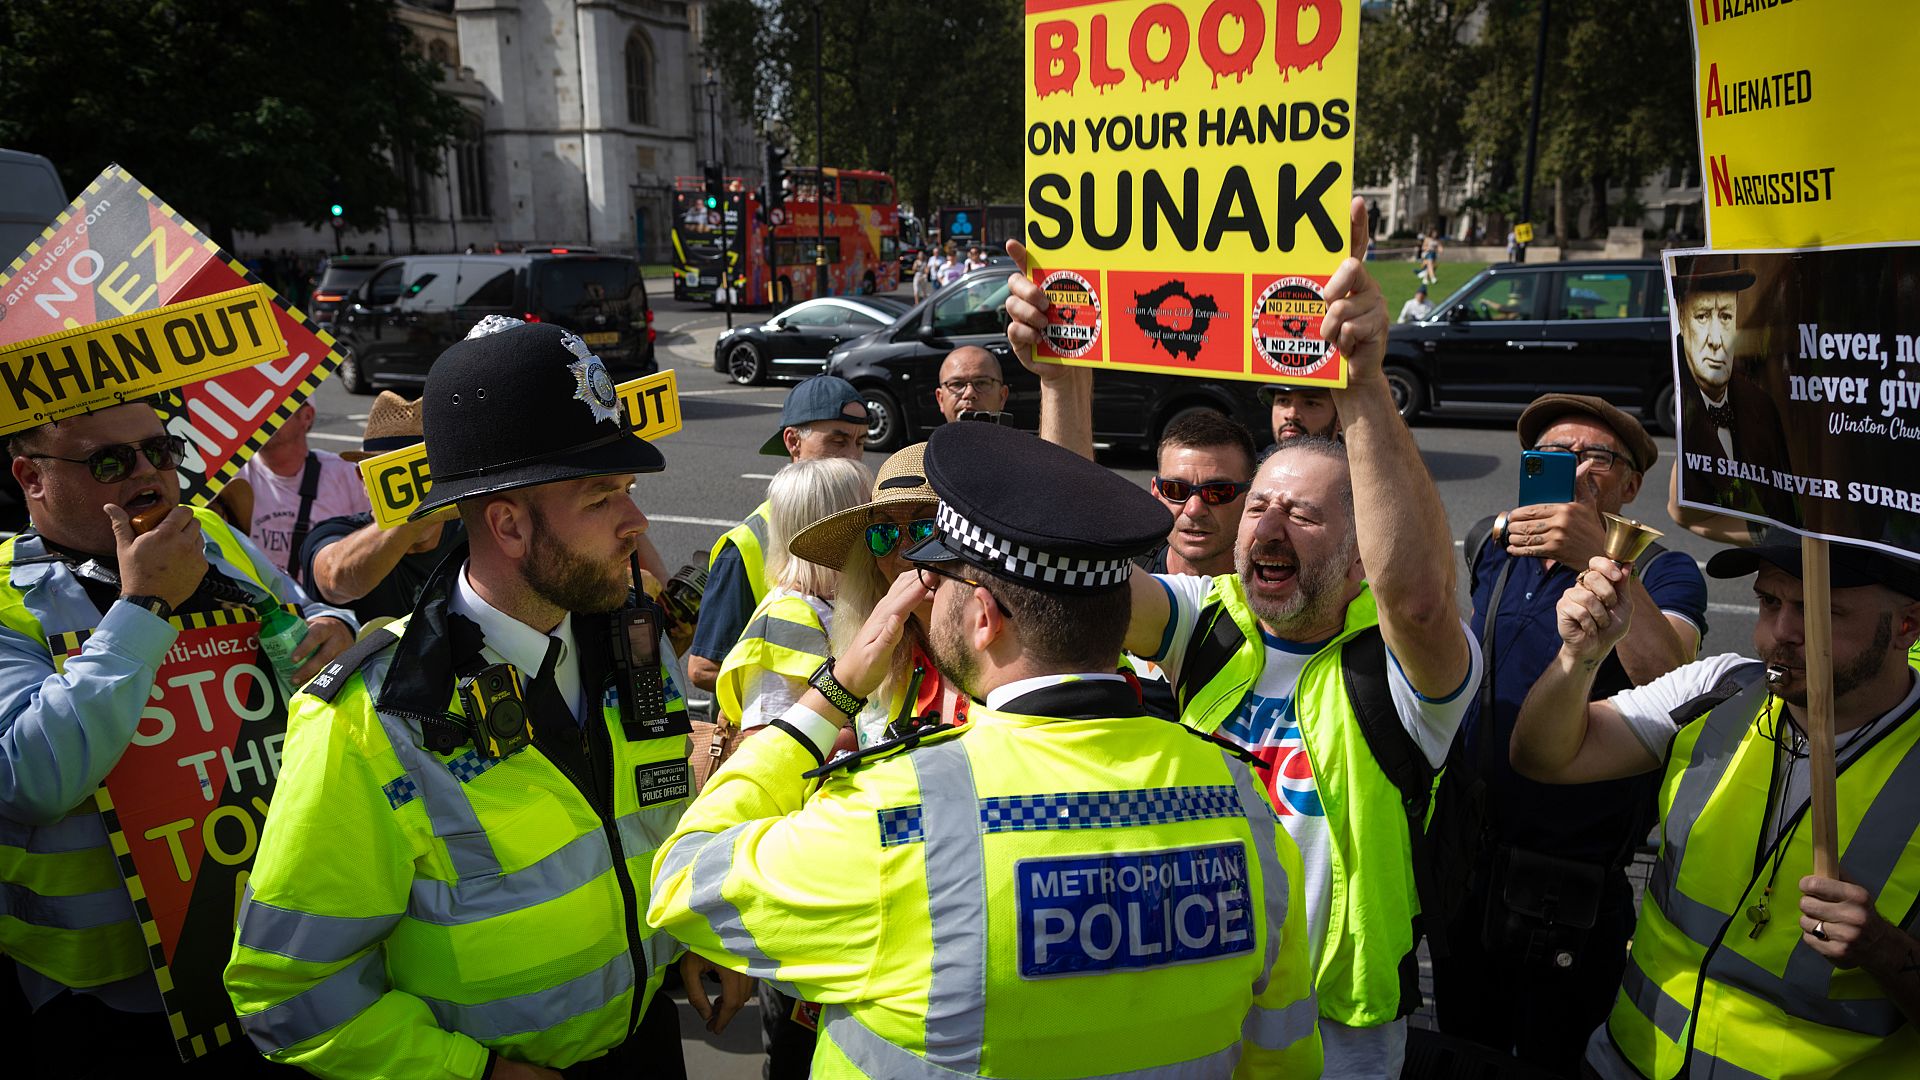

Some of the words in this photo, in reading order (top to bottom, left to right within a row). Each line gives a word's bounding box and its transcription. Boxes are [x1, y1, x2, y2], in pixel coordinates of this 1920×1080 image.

[1034, 0, 1343, 100] BLOOD
[1706, 63, 1812, 118] ALIENATED
[1027, 119, 1076, 156] ON
[1085, 112, 1187, 153] YOUR
[1199, 98, 1350, 147] HANDS
[1710, 155, 1835, 207] NARCISSIST
[1027, 161, 1344, 252] SUNAK
[6, 199, 111, 306] anti-ulez.com
[34, 249, 104, 319] NO
[1292, 291, 1313, 299] KHAN
[1059, 293, 1065, 303] 2
[1066, 293, 1088, 304] ULEZ
[1268, 301, 1283, 311] NO
[1285, 302, 1292, 312] 2
[1294, 302, 1323, 314] ULEZ
[1125, 306, 1146, 315] Action
[1147, 306, 1172, 318] Against
[1174, 308, 1194, 317] ULEZ
[1195, 308, 1230, 319] Extension
[1172, 320, 1179, 328] &
[1050, 326, 1062, 336] NO
[1063, 327, 1070, 337] 2
[1070, 327, 1087, 338] PPM
[1060, 338, 1080, 349] OUT
[1144, 329, 1161, 339] Road
[1178, 331, 1209, 343] charging
[1, 328, 163, 411] KHAN
[163, 300, 260, 366] OUT
[1271, 340, 1285, 351] NO
[1288, 341, 1295, 352] 2
[1298, 341, 1320, 353] PPM
[1798, 323, 1888, 370] Never,
[1281, 353, 1309, 366] OUT
[1790, 373, 1869, 405] never
[1828, 411, 1887, 436] Winston
[1685, 452, 1713, 474] WE
[1717, 457, 1769, 486] SHALL
[1772, 469, 1841, 501] NEVER
[130, 663, 288, 747] STO
[642, 717, 669, 727] CONSTABLE
[653, 766, 685, 777] METROPOLITAN
[657, 775, 681, 784] POLICE
[642, 789, 663, 802] POLICE
[663, 785, 687, 798] OFFICER
[1031, 856, 1240, 898] METROPOLITAN
[1033, 889, 1247, 965] POLICE
